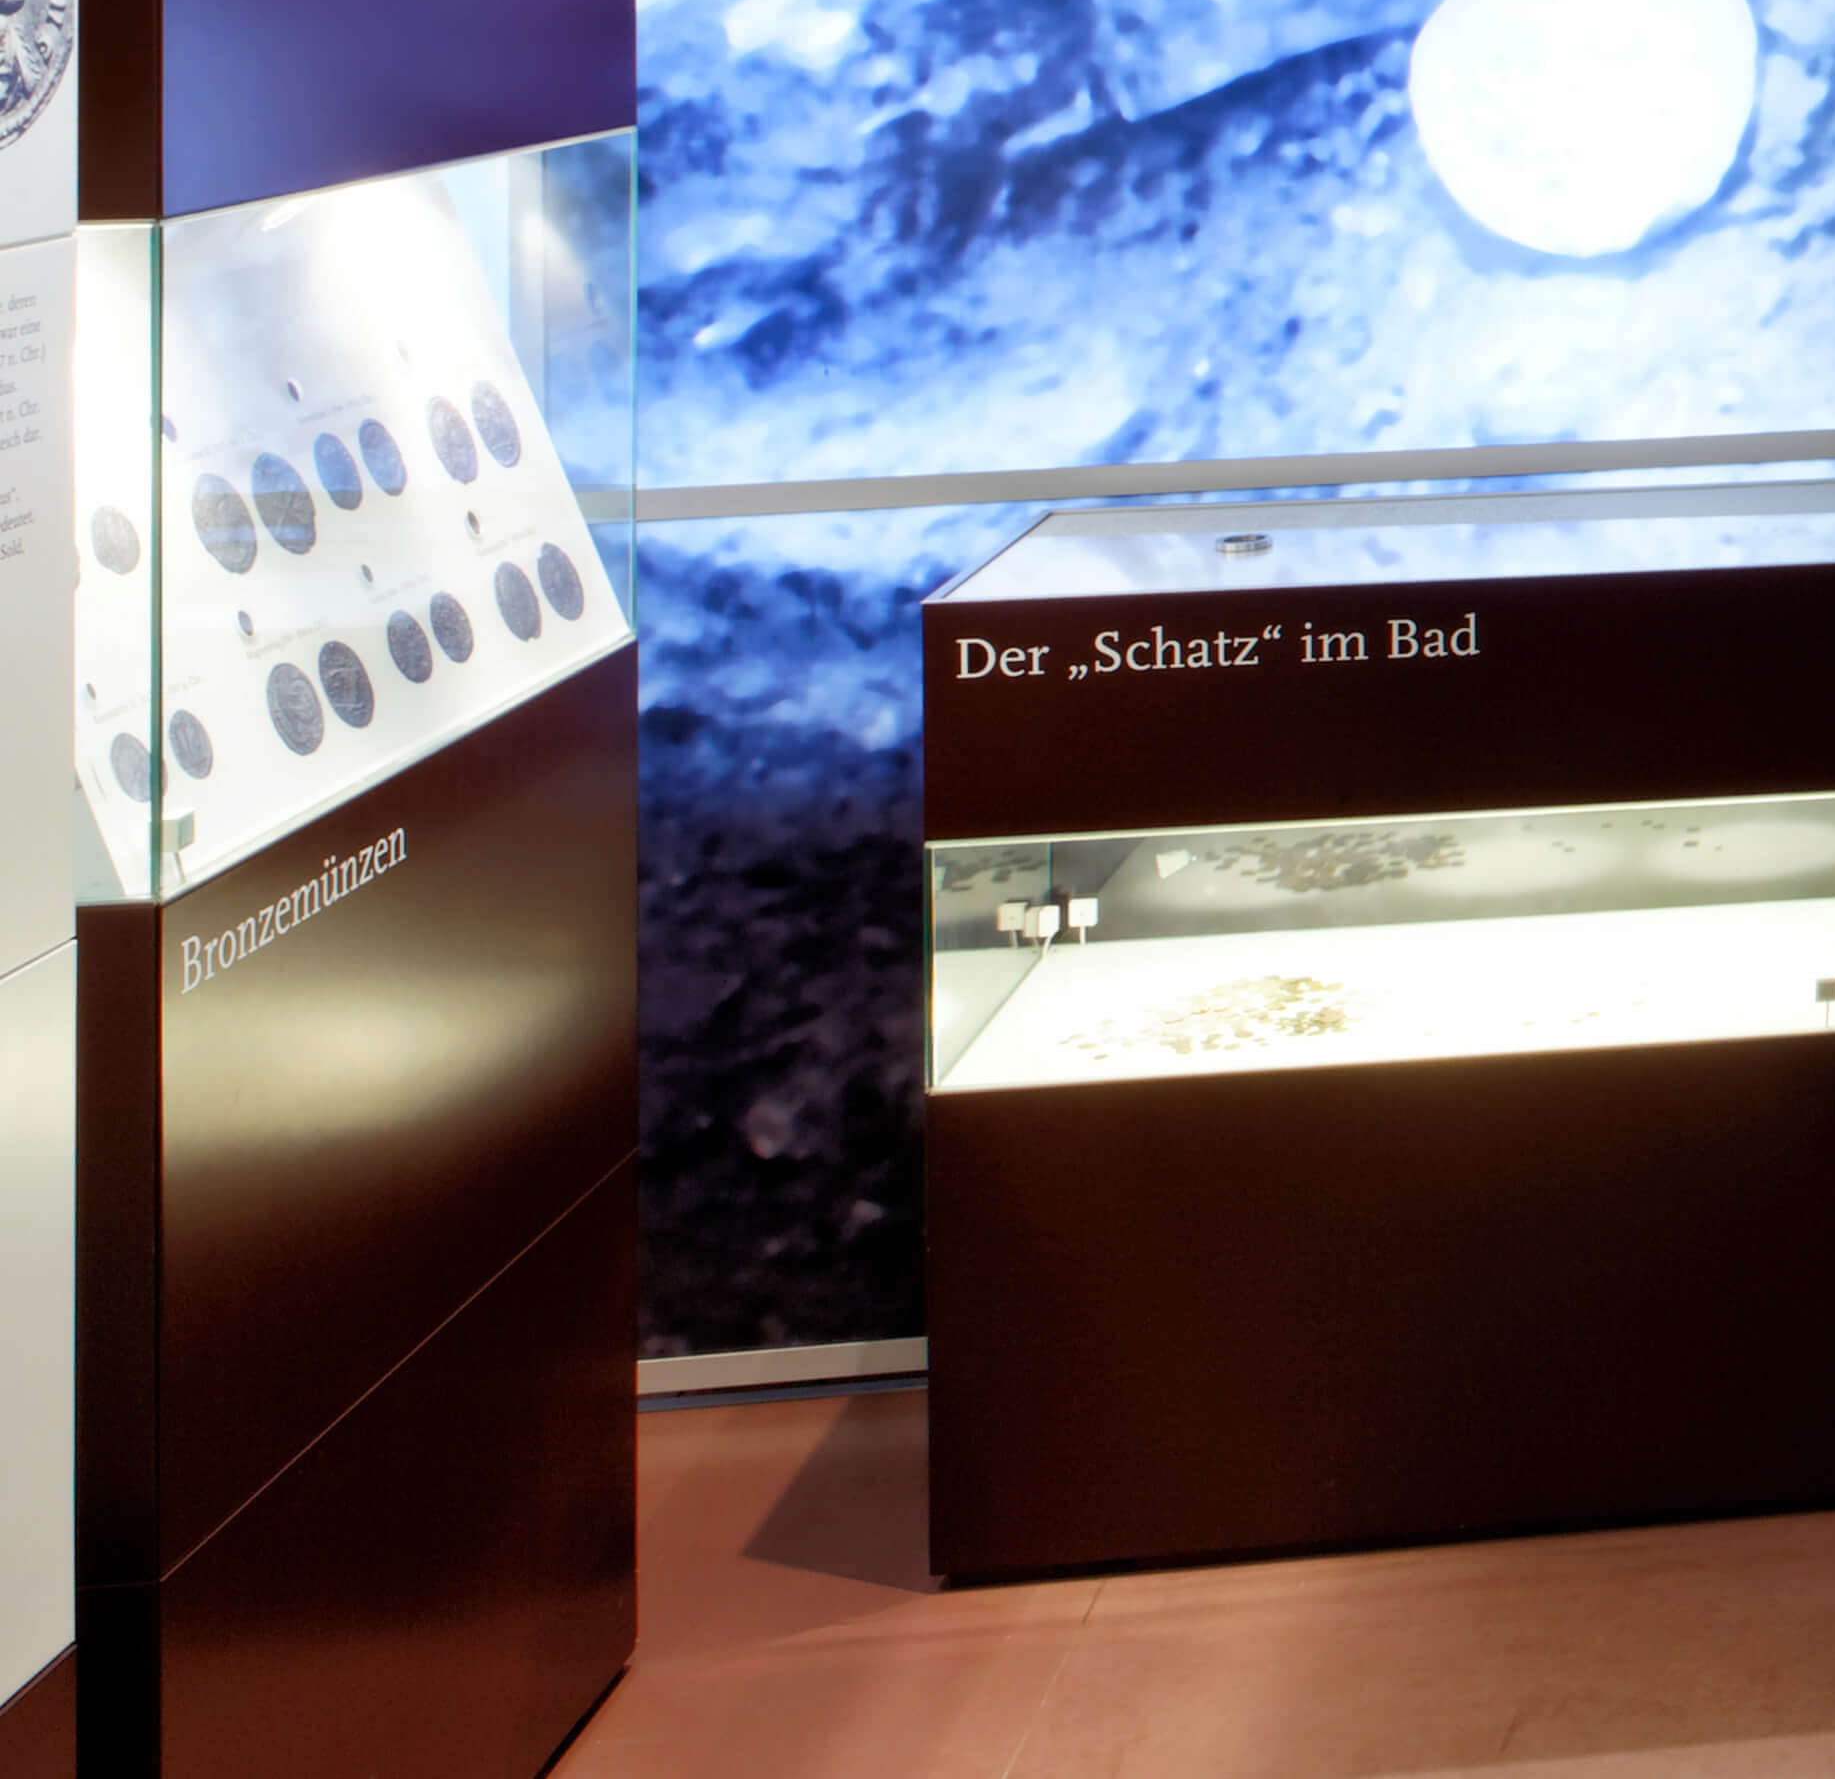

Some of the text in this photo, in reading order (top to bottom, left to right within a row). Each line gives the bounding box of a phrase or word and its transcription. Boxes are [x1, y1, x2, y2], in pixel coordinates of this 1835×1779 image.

[955, 637, 1050, 680] Der
[1300, 622, 1369, 663] im
[1387, 612, 1480, 660] Bad
[181, 827, 407, 995] Bronzemünzen
